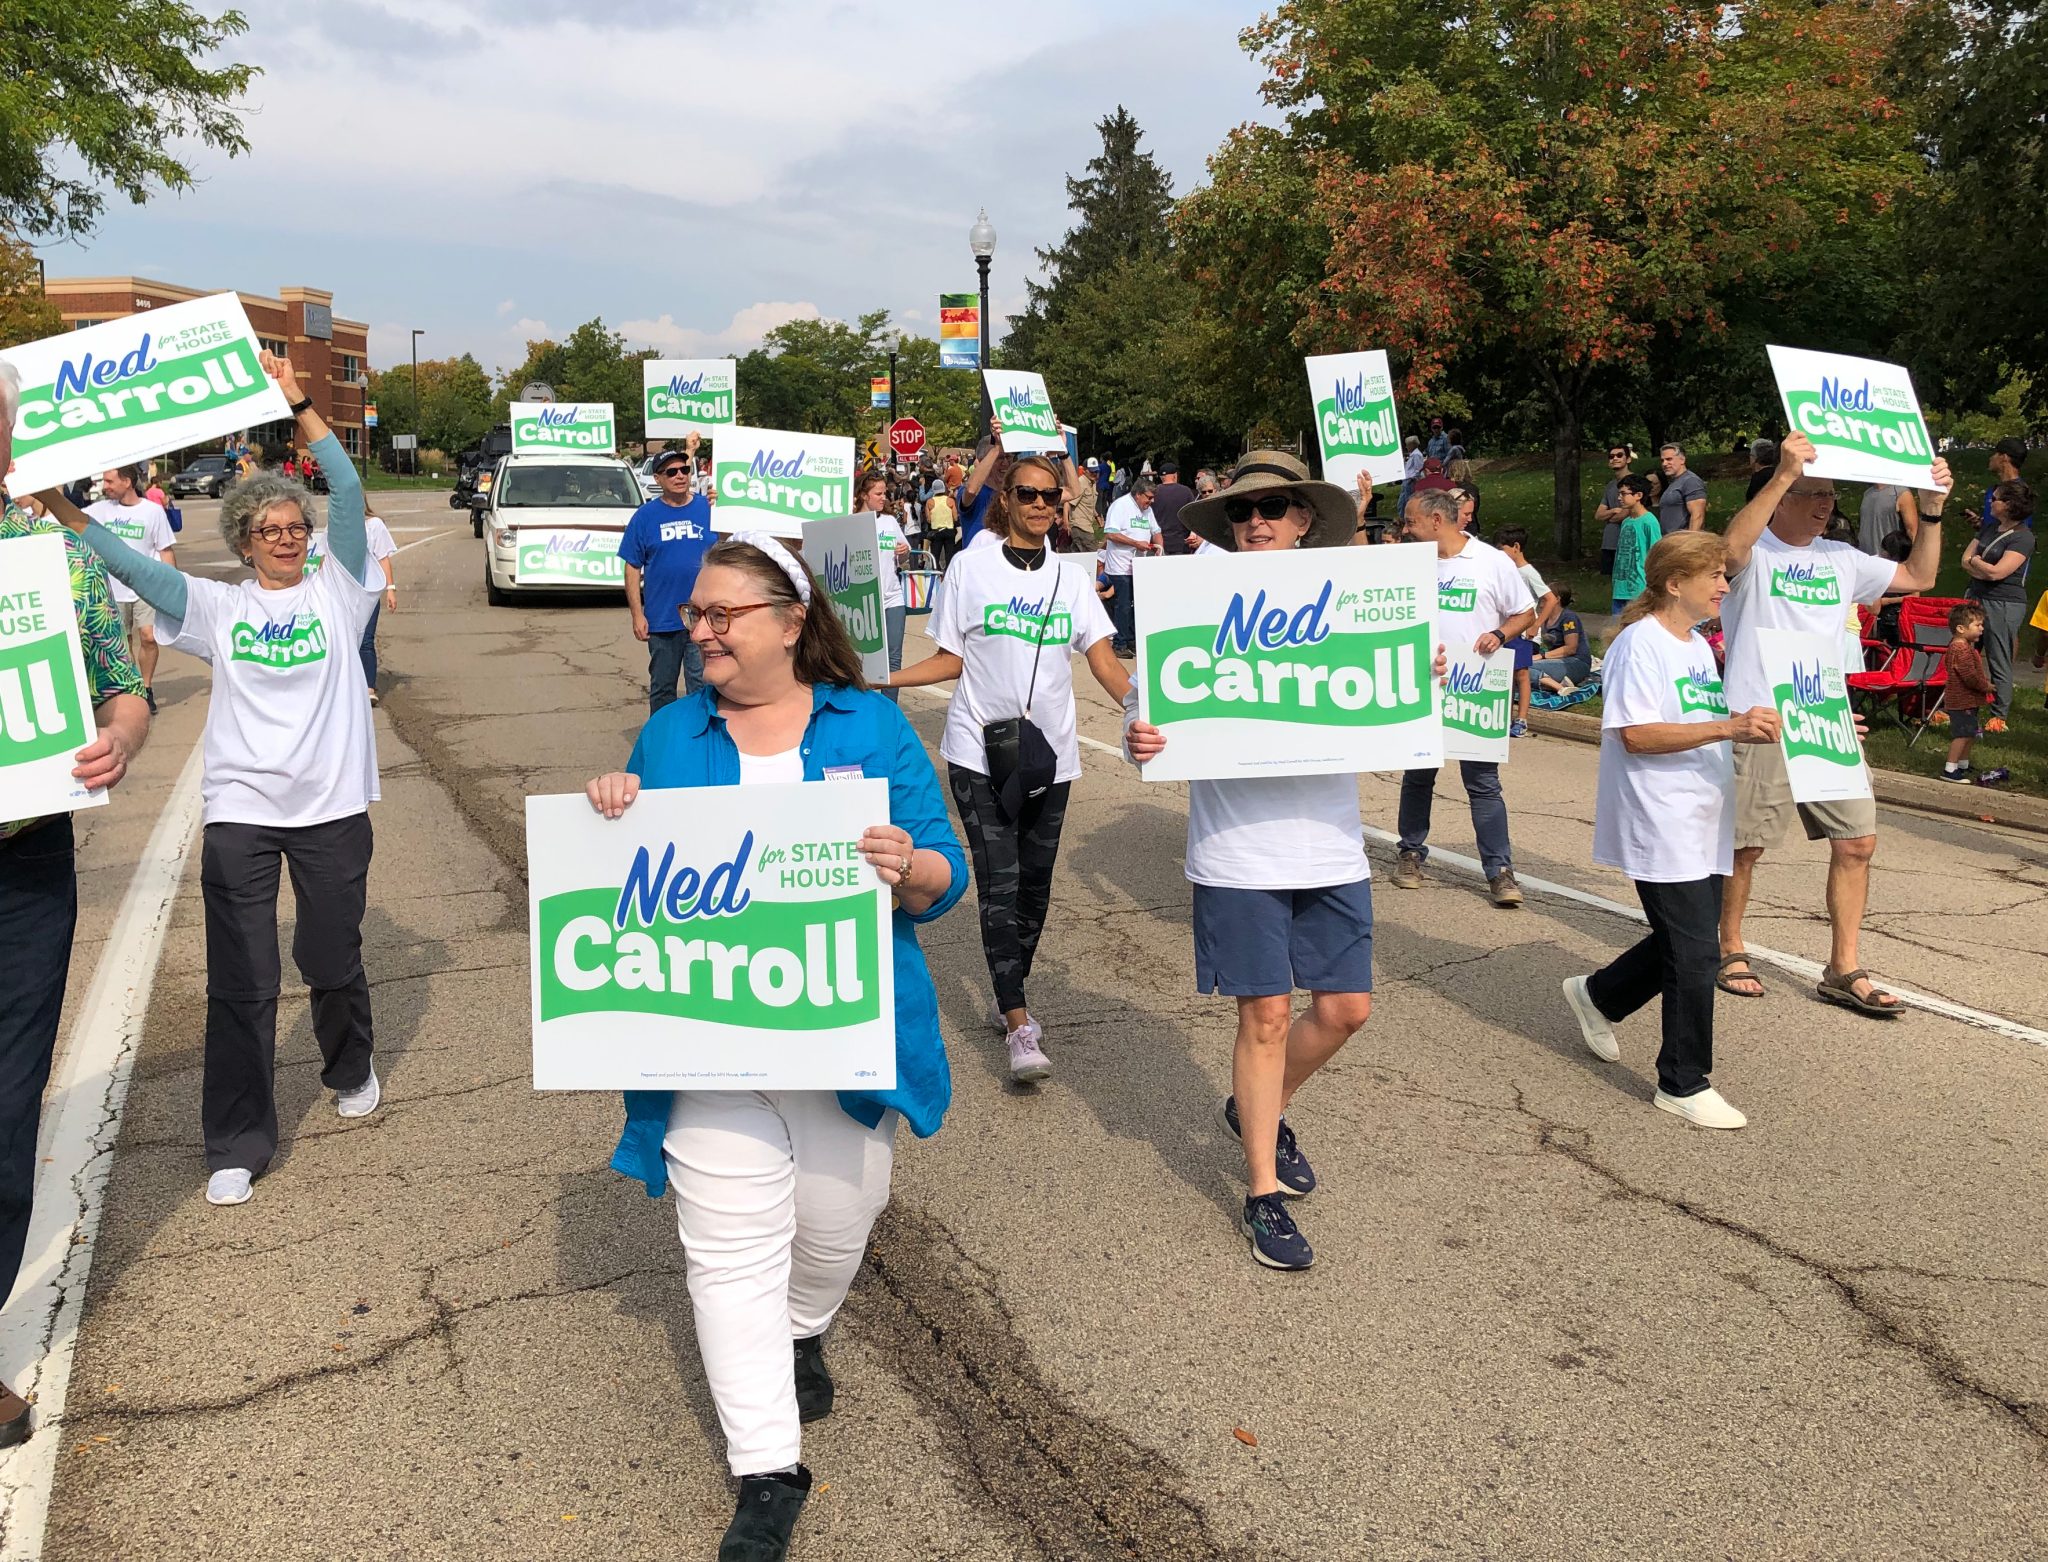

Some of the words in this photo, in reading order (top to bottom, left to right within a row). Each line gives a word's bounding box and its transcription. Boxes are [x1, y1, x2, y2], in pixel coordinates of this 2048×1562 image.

[158, 333, 177, 349] for
[180, 320, 229, 339] STATE
[176, 330, 233, 352] HOUSE
[55, 333, 157, 401] Ned
[1370, 375, 1385, 384] STATE
[12, 351, 255, 441] Carroll
[668, 372, 703, 396] Ned
[1009, 384, 1033, 407] Ned
[1335, 370, 1365, 416] Ned
[1821, 375, 1874, 411] Ned
[1882, 387, 1907, 400] STATE
[651, 392, 729, 418] Carroll
[1881, 397, 1911, 409] HOUSE
[538, 405, 578, 427] Ned
[1000, 404, 1056, 432] Carroll
[1323, 407, 1395, 447] Carroll
[1798, 401, 1926, 456] Carroll
[518, 422, 608, 445] Carroll
[891, 429, 923, 444] STOP
[749, 449, 805, 478] Ned
[814, 465, 844, 474] HOUSE
[818, 456, 844, 466] STATE
[722, 470, 843, 514] Carroll
[546, 533, 591, 554] Ned
[661, 525, 698, 542] DFL
[523, 550, 623, 577] Carroll
[855, 549, 872, 562] STATE
[824, 543, 850, 594] Ned
[854, 564, 873, 576] HOUSE
[1784, 562, 1815, 582] Ned
[1438, 575, 1455, 591] ed
[1775, 576, 1838, 601] Carroll
[0, 590, 43, 613] ATE
[1006, 596, 1044, 617] Ned
[1336, 590, 1359, 612] for
[1363, 587, 1416, 603] STATE
[0, 614, 47, 636] USE
[987, 610, 1069, 640] Carroll
[1216, 579, 1332, 656] Ned
[1354, 605, 1416, 623] HOUSE
[256, 614, 296, 642] Ned
[235, 625, 327, 662] Carroll
[1159, 643, 1420, 711] Carroll
[1446, 661, 1486, 695] Ned
[1489, 678, 1508, 687] HOUSE
[1492, 668, 1508, 677] STATE
[1688, 663, 1711, 687] Ned
[1792, 657, 1825, 706] Ned
[1441, 688, 1505, 731] arroll
[1782, 698, 1857, 755] Carroll
[758, 844, 786, 872] for
[792, 841, 859, 862] STATE
[617, 829, 754, 928] Ned
[780, 867, 859, 889] HOUSE
[553, 914, 864, 1007] Carroll
